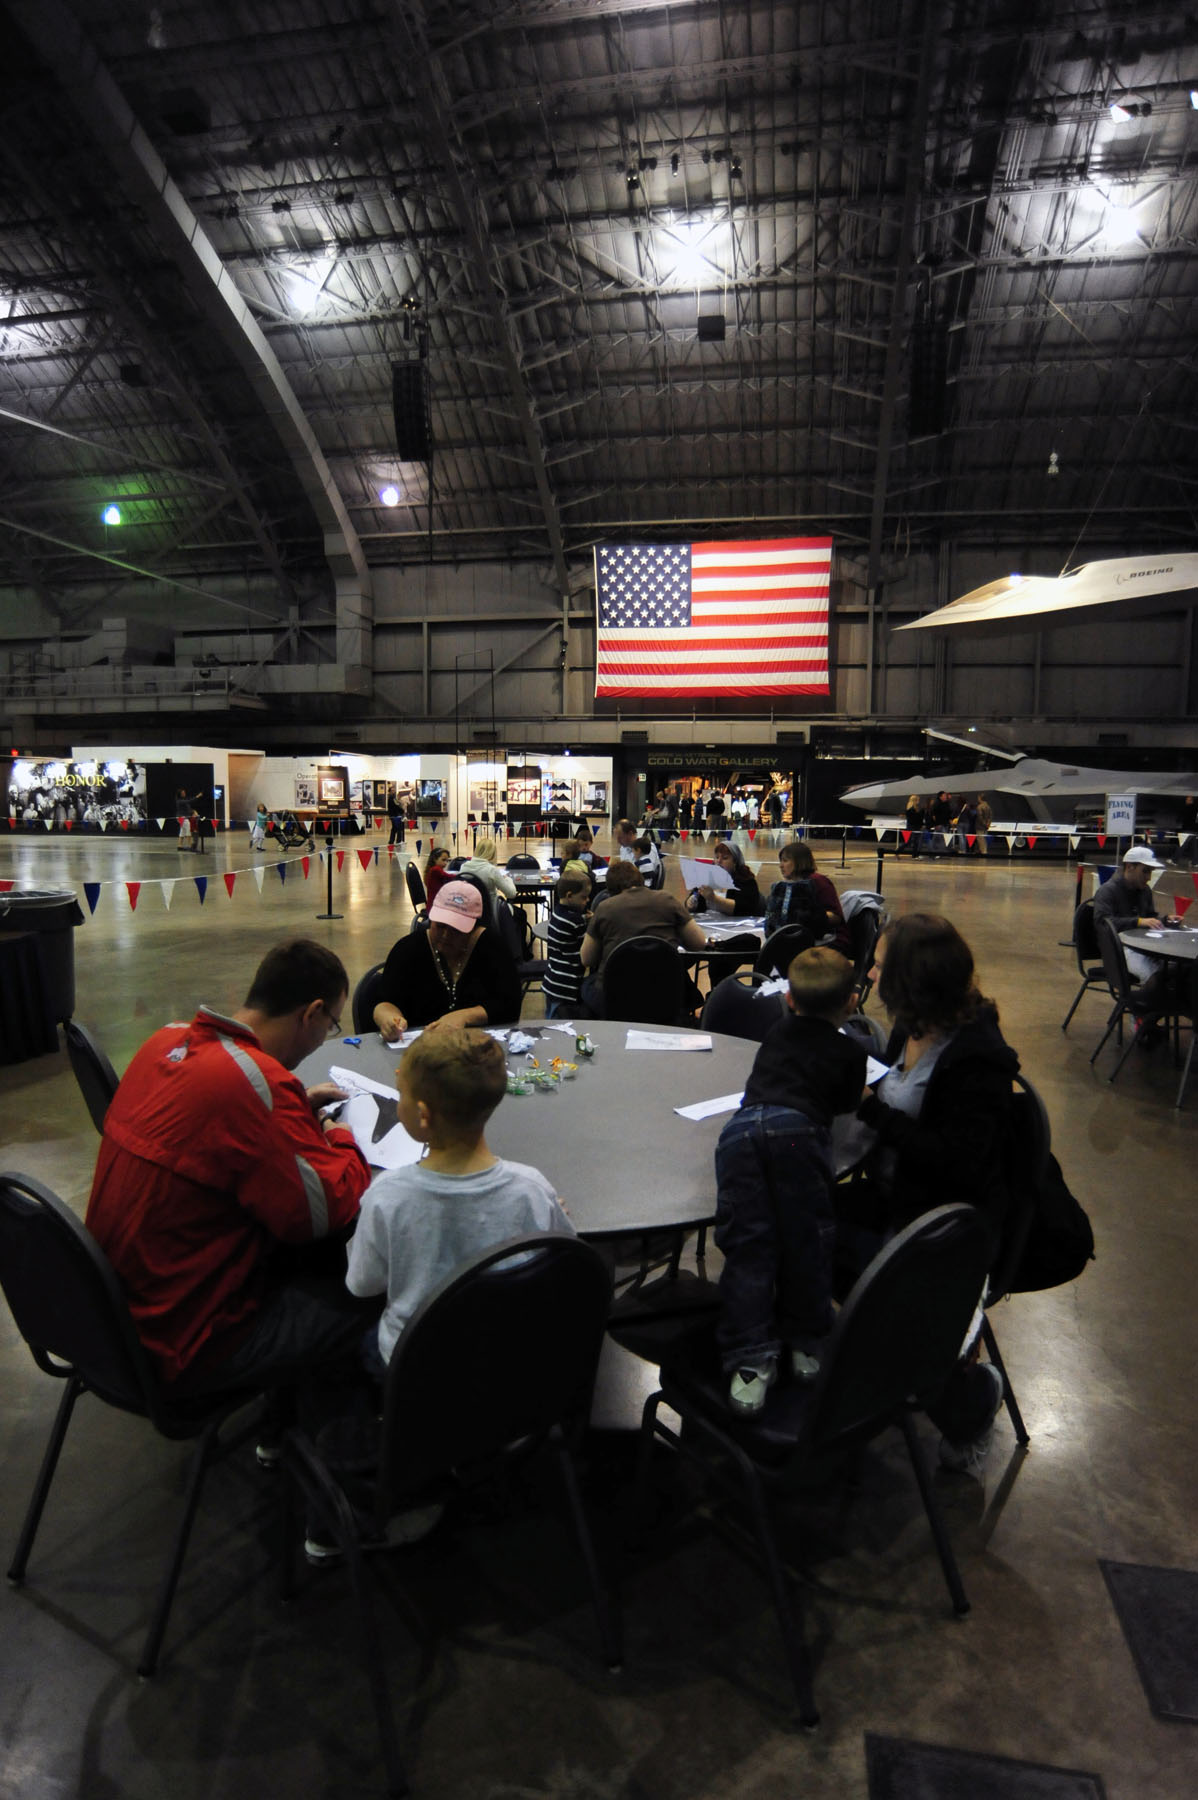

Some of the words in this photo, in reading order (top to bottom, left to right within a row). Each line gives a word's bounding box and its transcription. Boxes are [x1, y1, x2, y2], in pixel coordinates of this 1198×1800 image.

[1130, 567, 1174, 578] BOEING
[648, 757, 682, 765] COLD
[686, 757, 717, 765] WAR
[719, 757, 778, 766] GALLERY
[55, 774, 106, 787] HONOR
[1108, 800, 1133, 809] FLYING
[1112, 811, 1130, 820] AREA
